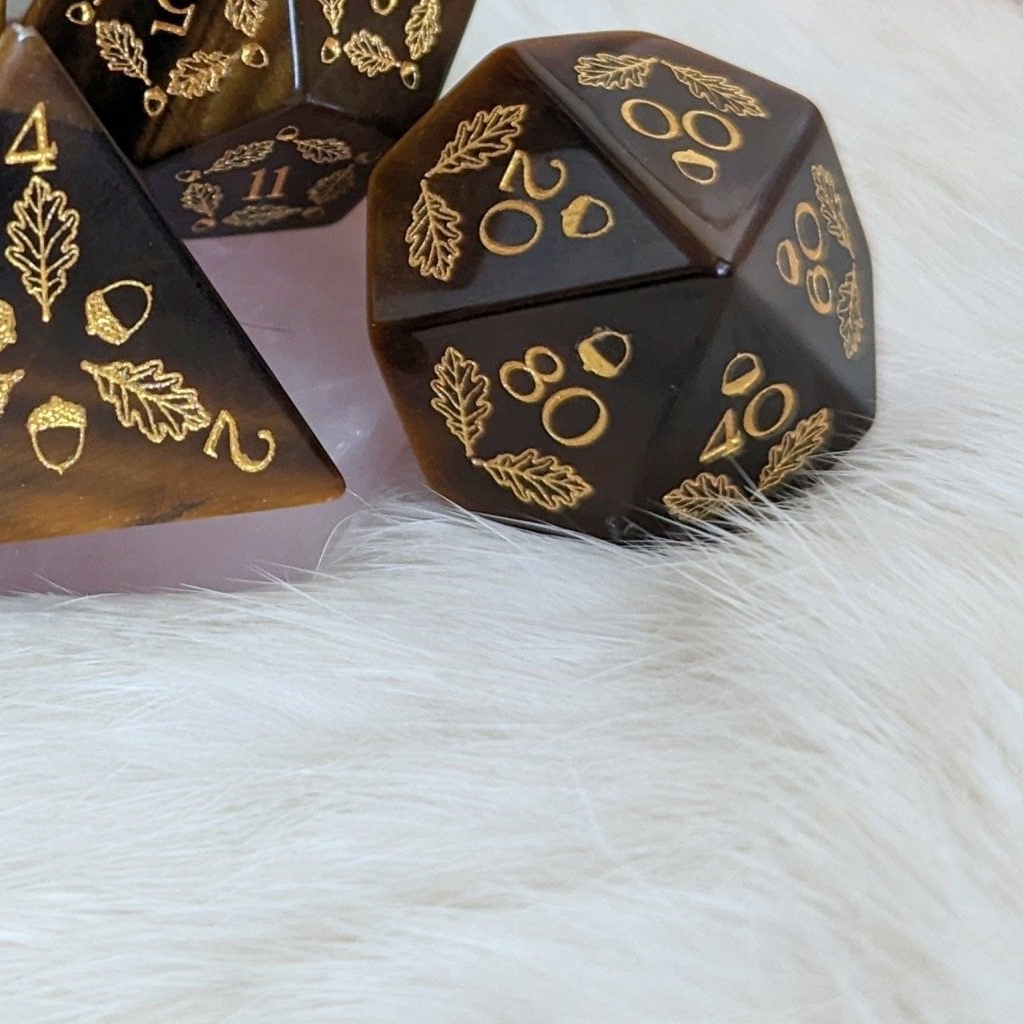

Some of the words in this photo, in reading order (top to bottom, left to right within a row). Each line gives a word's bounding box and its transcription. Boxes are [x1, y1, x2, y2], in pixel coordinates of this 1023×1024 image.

[4, 101, 59, 172] 4
[620, 96, 743, 153] 00
[243, 165, 290, 202] 11
[479, 148, 568, 256] 20
[498, 344, 613, 448] 80
[699, 381, 799, 464] 40
[202, 408, 277, 474] 2
